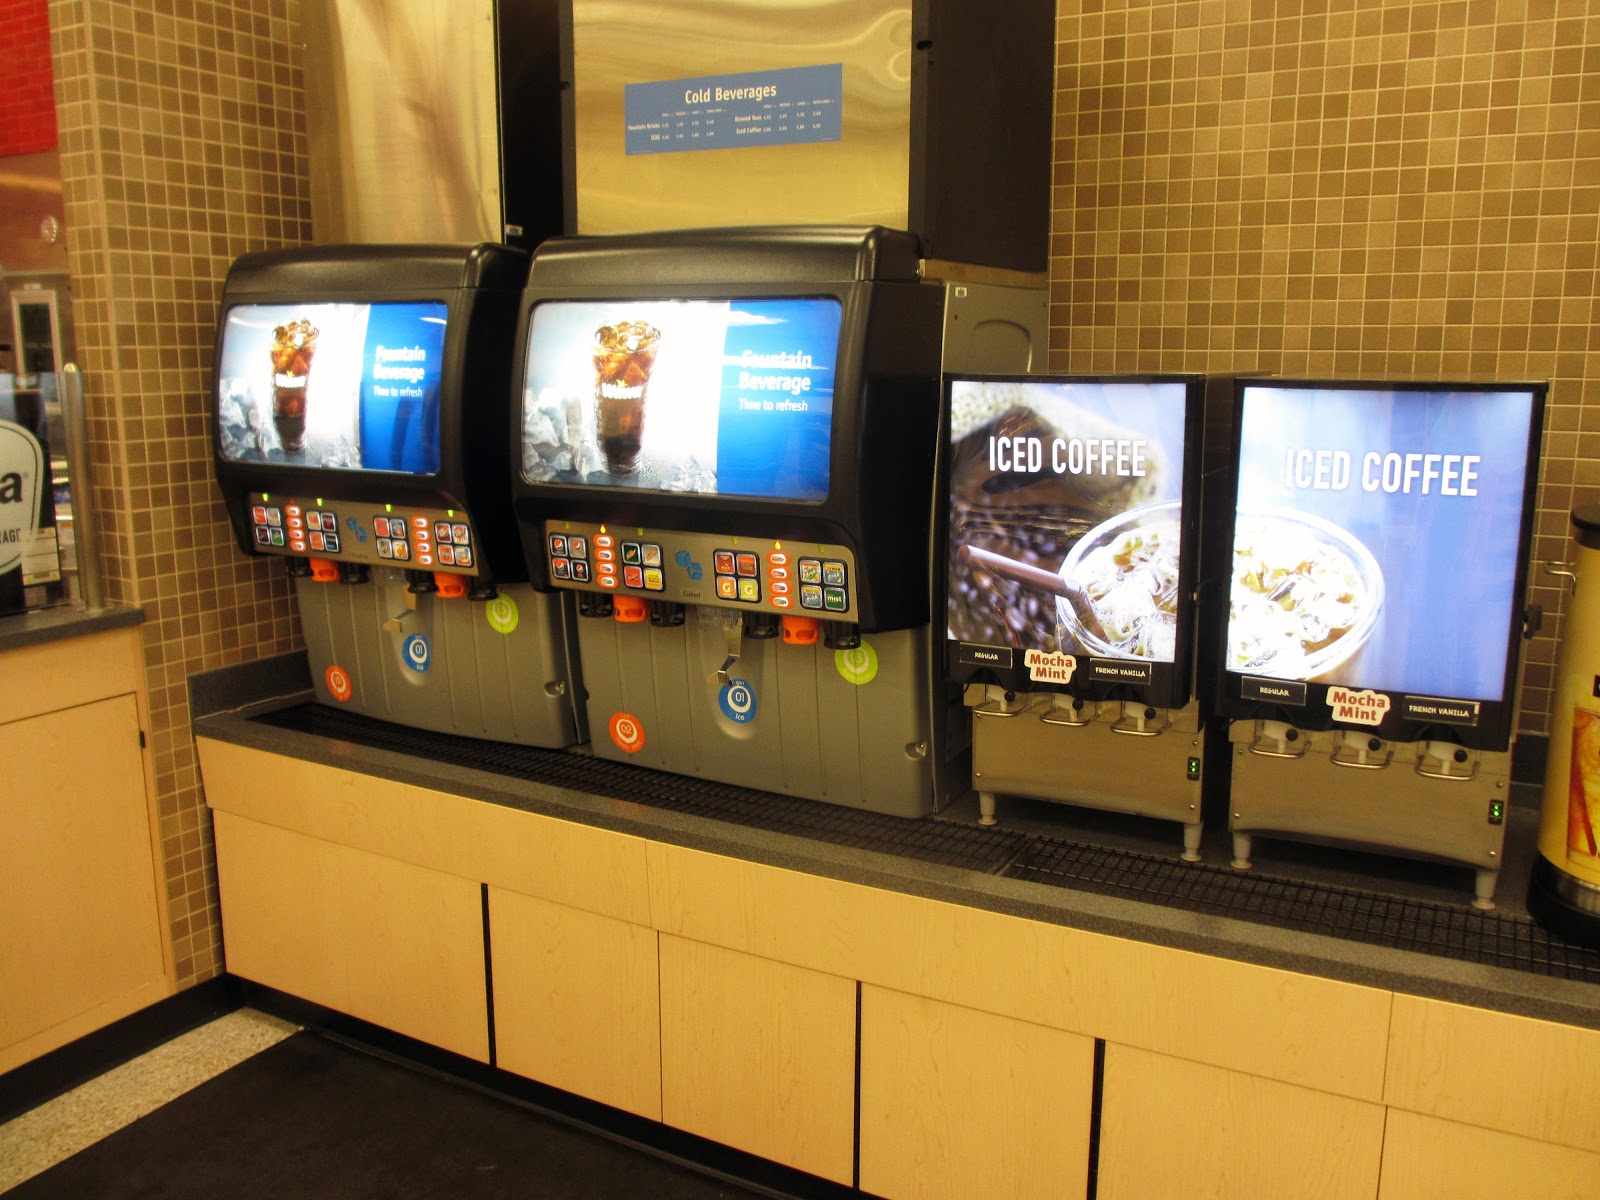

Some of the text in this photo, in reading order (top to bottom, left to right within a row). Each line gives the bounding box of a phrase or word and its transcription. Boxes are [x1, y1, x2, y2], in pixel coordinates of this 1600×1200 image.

[684, 85, 777, 104] Cold Beverages
[376, 346, 425, 361] Fountain
[740, 350, 812, 369] Fountain
[373, 363, 425, 383] Beverage
[373, 385, 422, 397] Time to refresh
[739, 372, 811, 395] Beverage
[739, 398, 808, 412] Time to refresh
[989, 436, 1147, 477] ICED COFFEE
[1284, 448, 1481, 497] ICED COFFEE
[0, 528, 21, 544] AGE
[415, 644, 423, 654] 01
[974, 651, 998, 661] REGULAR
[1030, 653, 1073, 668] Mocha
[1035, 666, 1066, 680] Mint
[1095, 667, 1146, 678] FRENCH VANILLA
[735, 692, 745, 703] 01
[1259, 686, 1289, 697] REGULAR
[1332, 691, 1386, 708] Mocha
[735, 713, 745, 721] ice
[1339, 706, 1377, 721] Mint
[1408, 705, 1469, 718] FRENCH VANILLA
